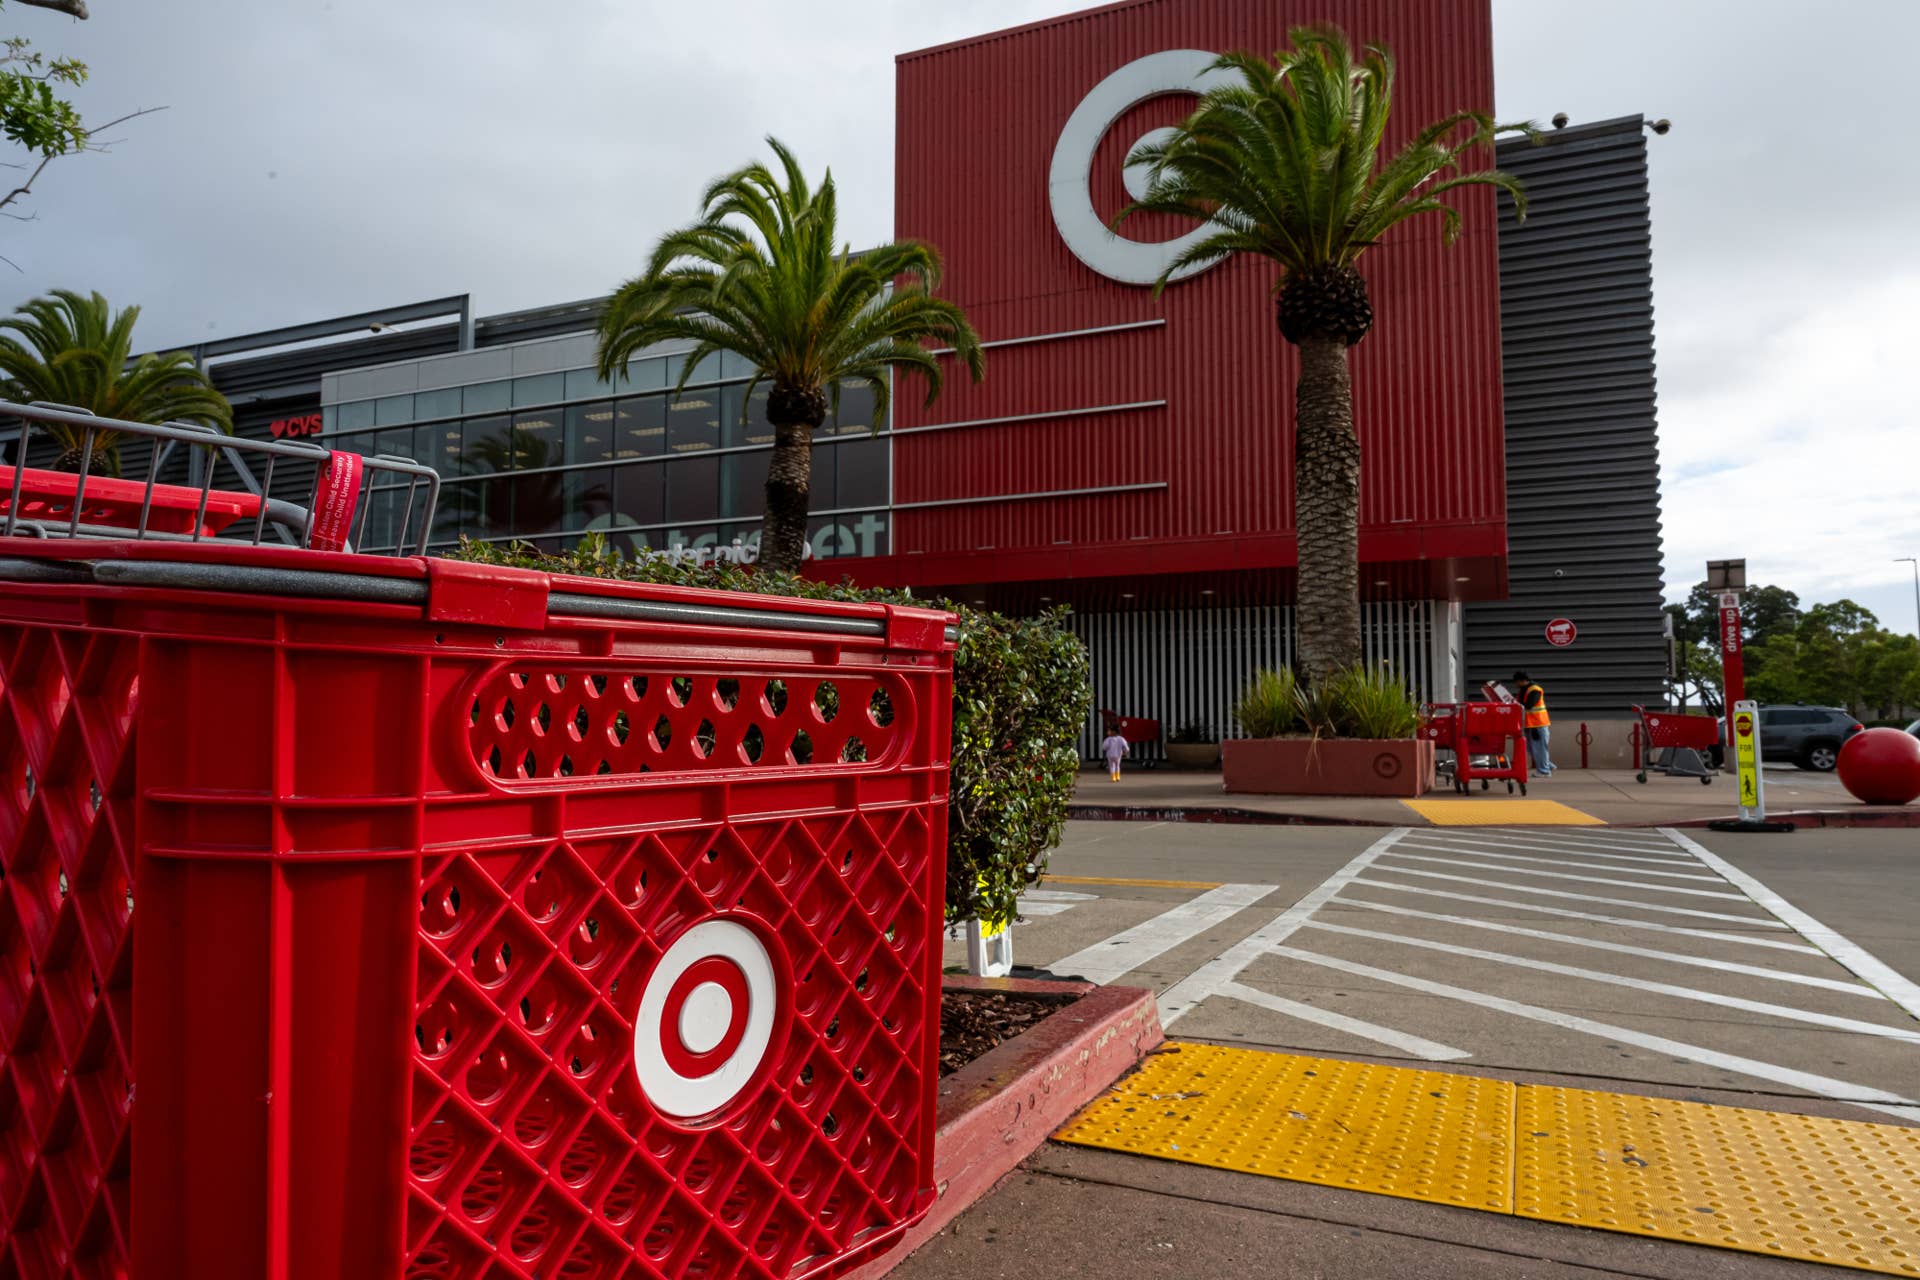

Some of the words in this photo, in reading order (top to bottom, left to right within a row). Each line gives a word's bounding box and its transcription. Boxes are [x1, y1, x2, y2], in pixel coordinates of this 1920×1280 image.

[286, 413, 323, 437] CVS
[325, 490, 337, 509] Child
[331, 455, 345, 489] Securely
[334, 497, 346, 519] Child
[340, 454, 353, 498] Unattended
[1726, 609, 1737, 624] up
[1725, 626, 1737, 652] drive
